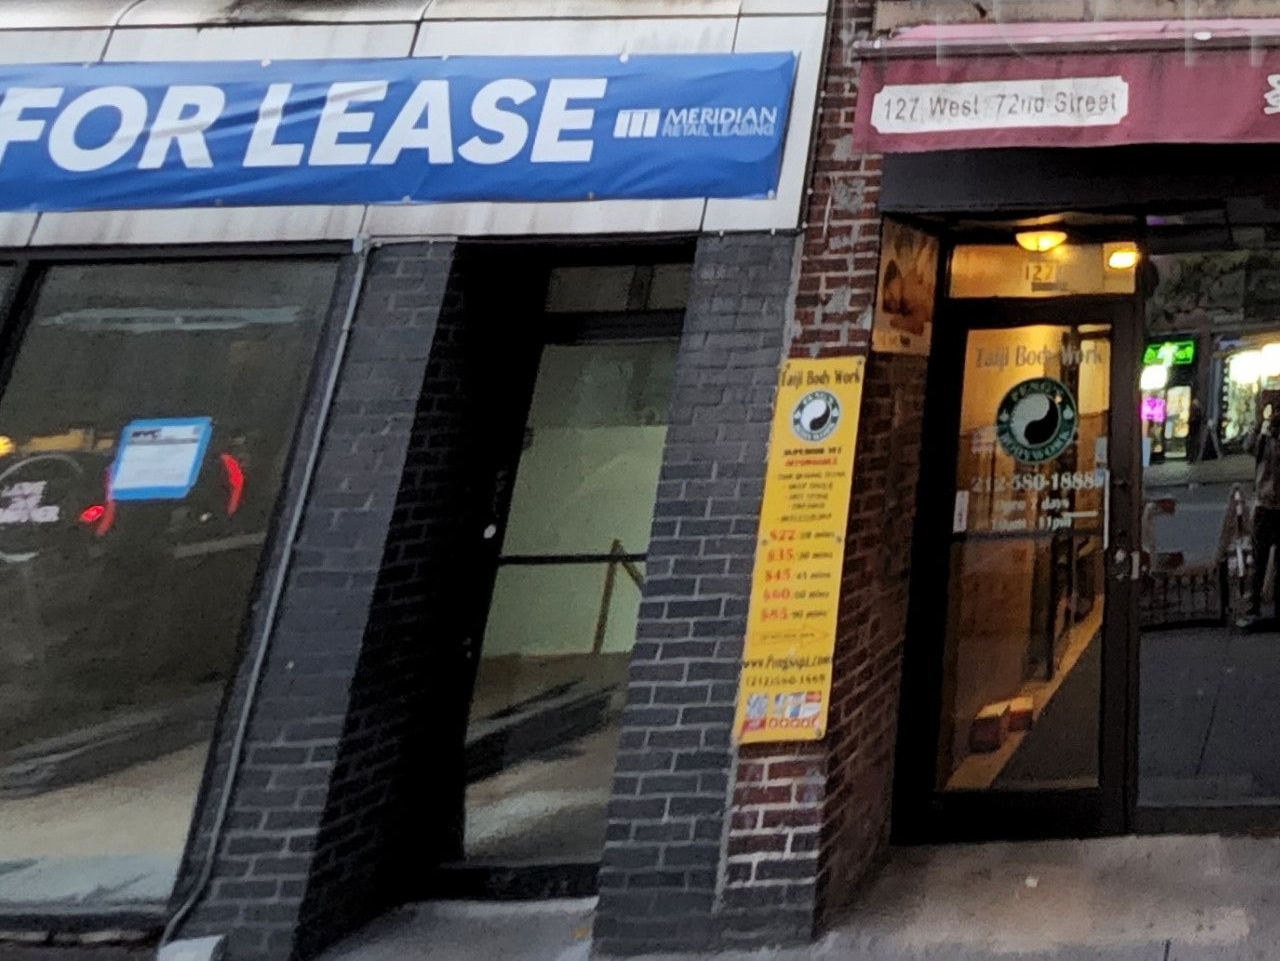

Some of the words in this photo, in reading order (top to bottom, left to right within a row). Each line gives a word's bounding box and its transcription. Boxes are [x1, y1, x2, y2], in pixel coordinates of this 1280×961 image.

[884, 98, 919, 120] 127
[929, 95, 979, 118] West
[996, 93, 1045, 115] 72nd
[1054, 91, 1118, 115] Street
[0, 85, 226, 172] FOR
[243, 77, 608, 167] LEASE
[666, 106, 778, 125] MERIDIAN
[662, 123, 710, 137] RETAIL
[712, 122, 775, 137] LEASING
[1024, 264, 1056, 281] 127
